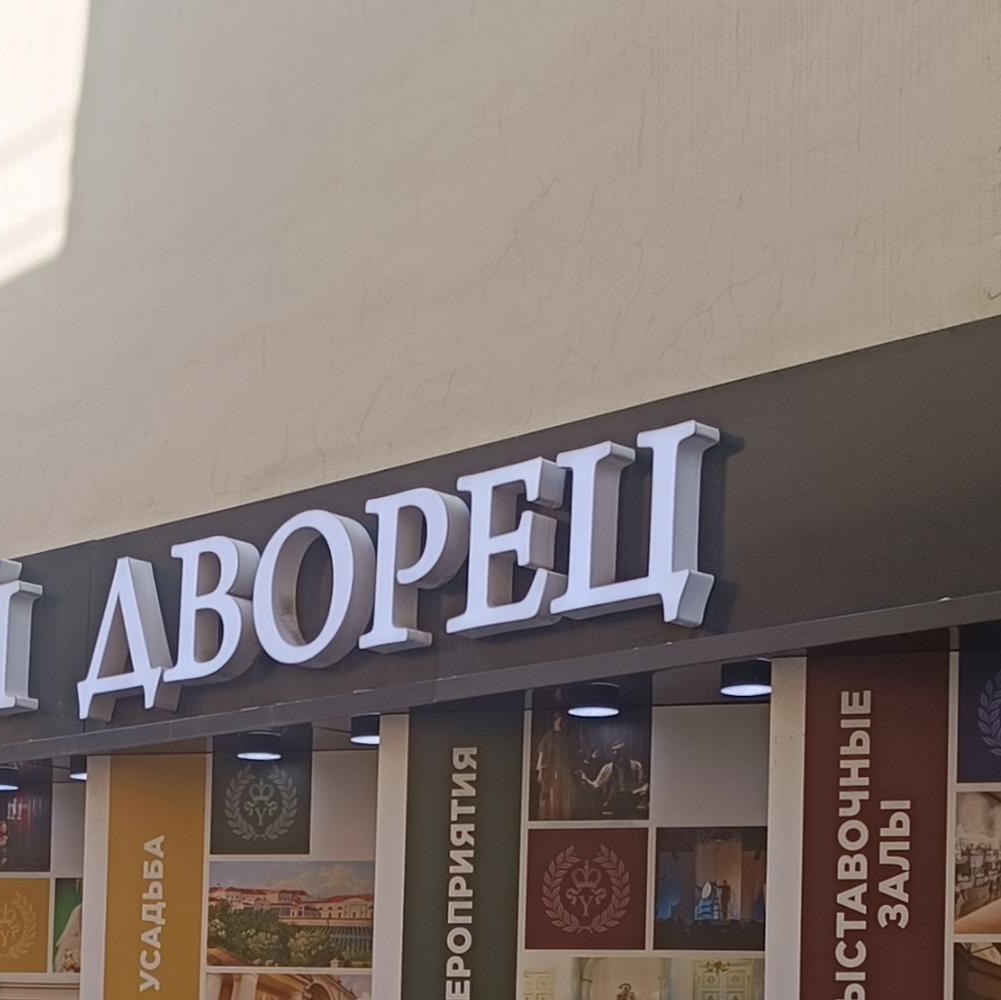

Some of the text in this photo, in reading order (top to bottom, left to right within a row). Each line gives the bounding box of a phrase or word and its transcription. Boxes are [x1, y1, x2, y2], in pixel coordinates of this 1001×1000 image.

[77, 419, 721, 721] ДВОРЕЦ
[138, 833, 168, 993] УСАДЬБА
[877, 799, 912, 930] ЗАЛЫ
